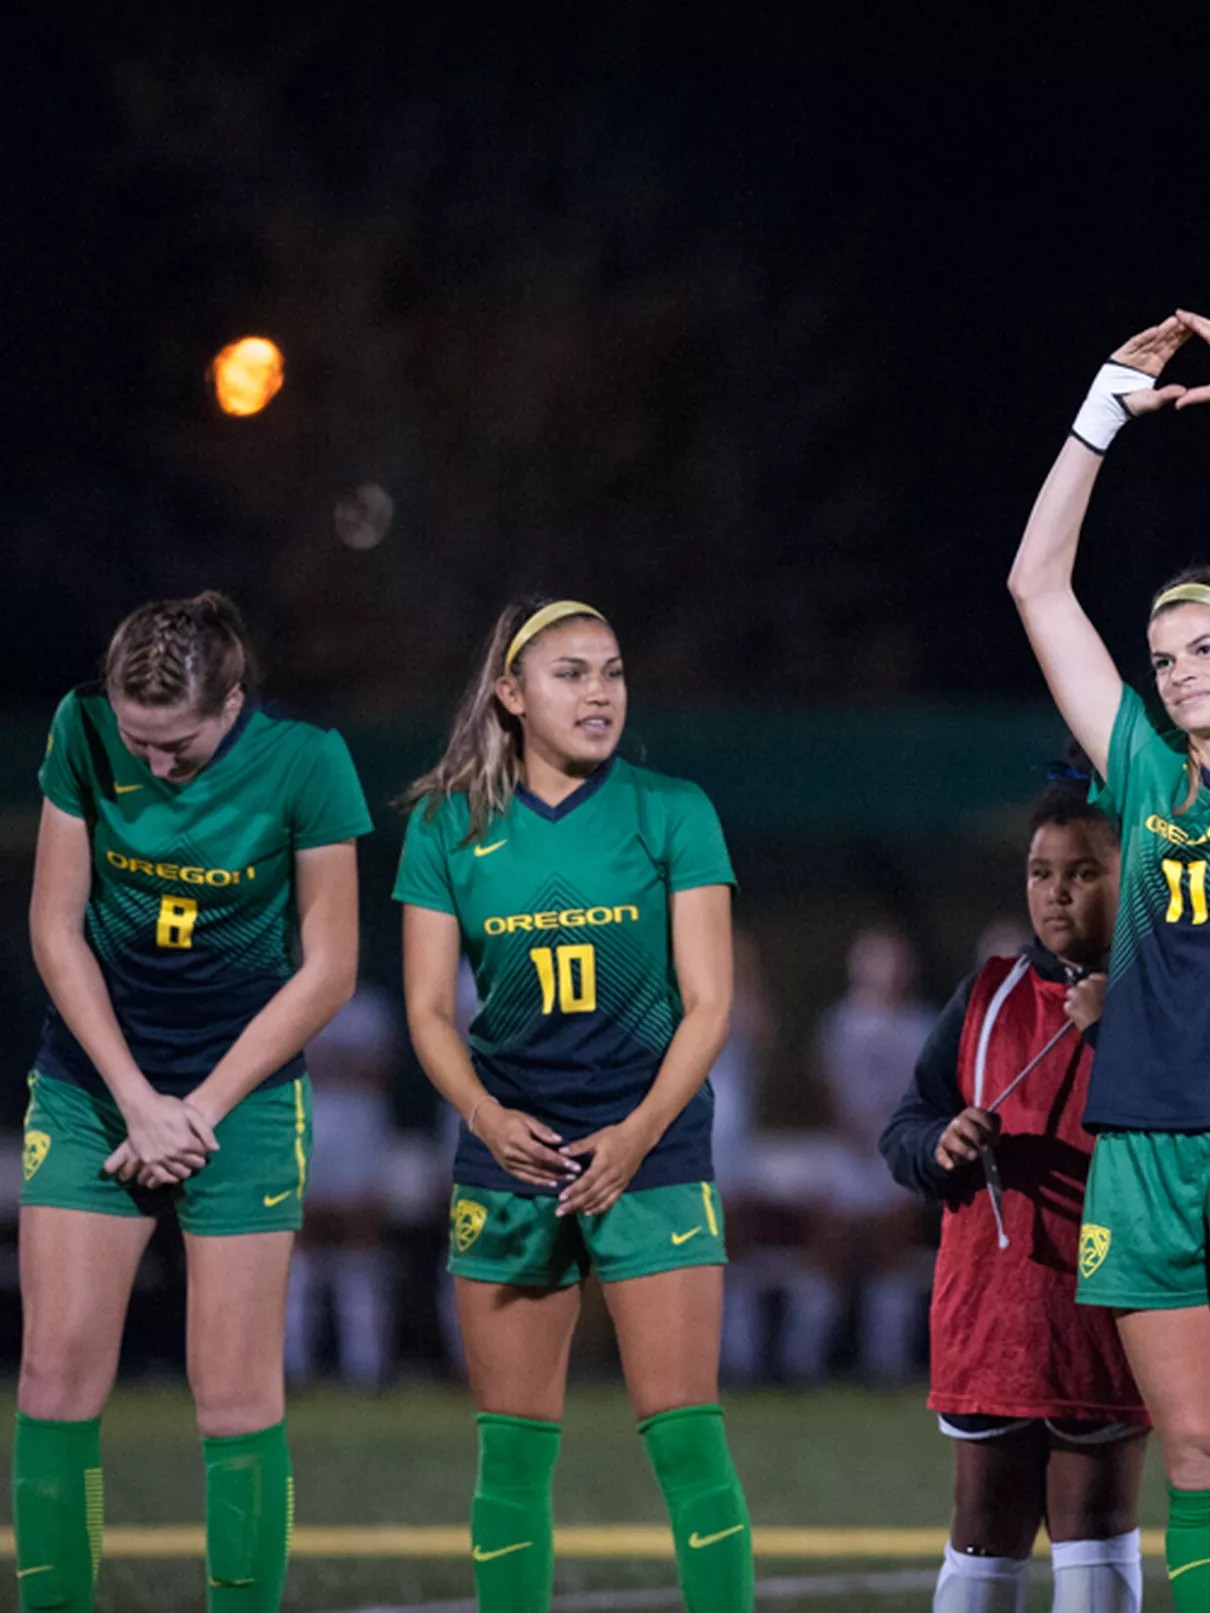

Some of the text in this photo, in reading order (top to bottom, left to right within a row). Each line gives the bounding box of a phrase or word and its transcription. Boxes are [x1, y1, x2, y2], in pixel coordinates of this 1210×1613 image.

[155, 893, 199, 949] 8
[483, 904, 640, 936] OREGON
[1162, 858, 1209, 925] 11
[529, 943, 597, 1015] 10
